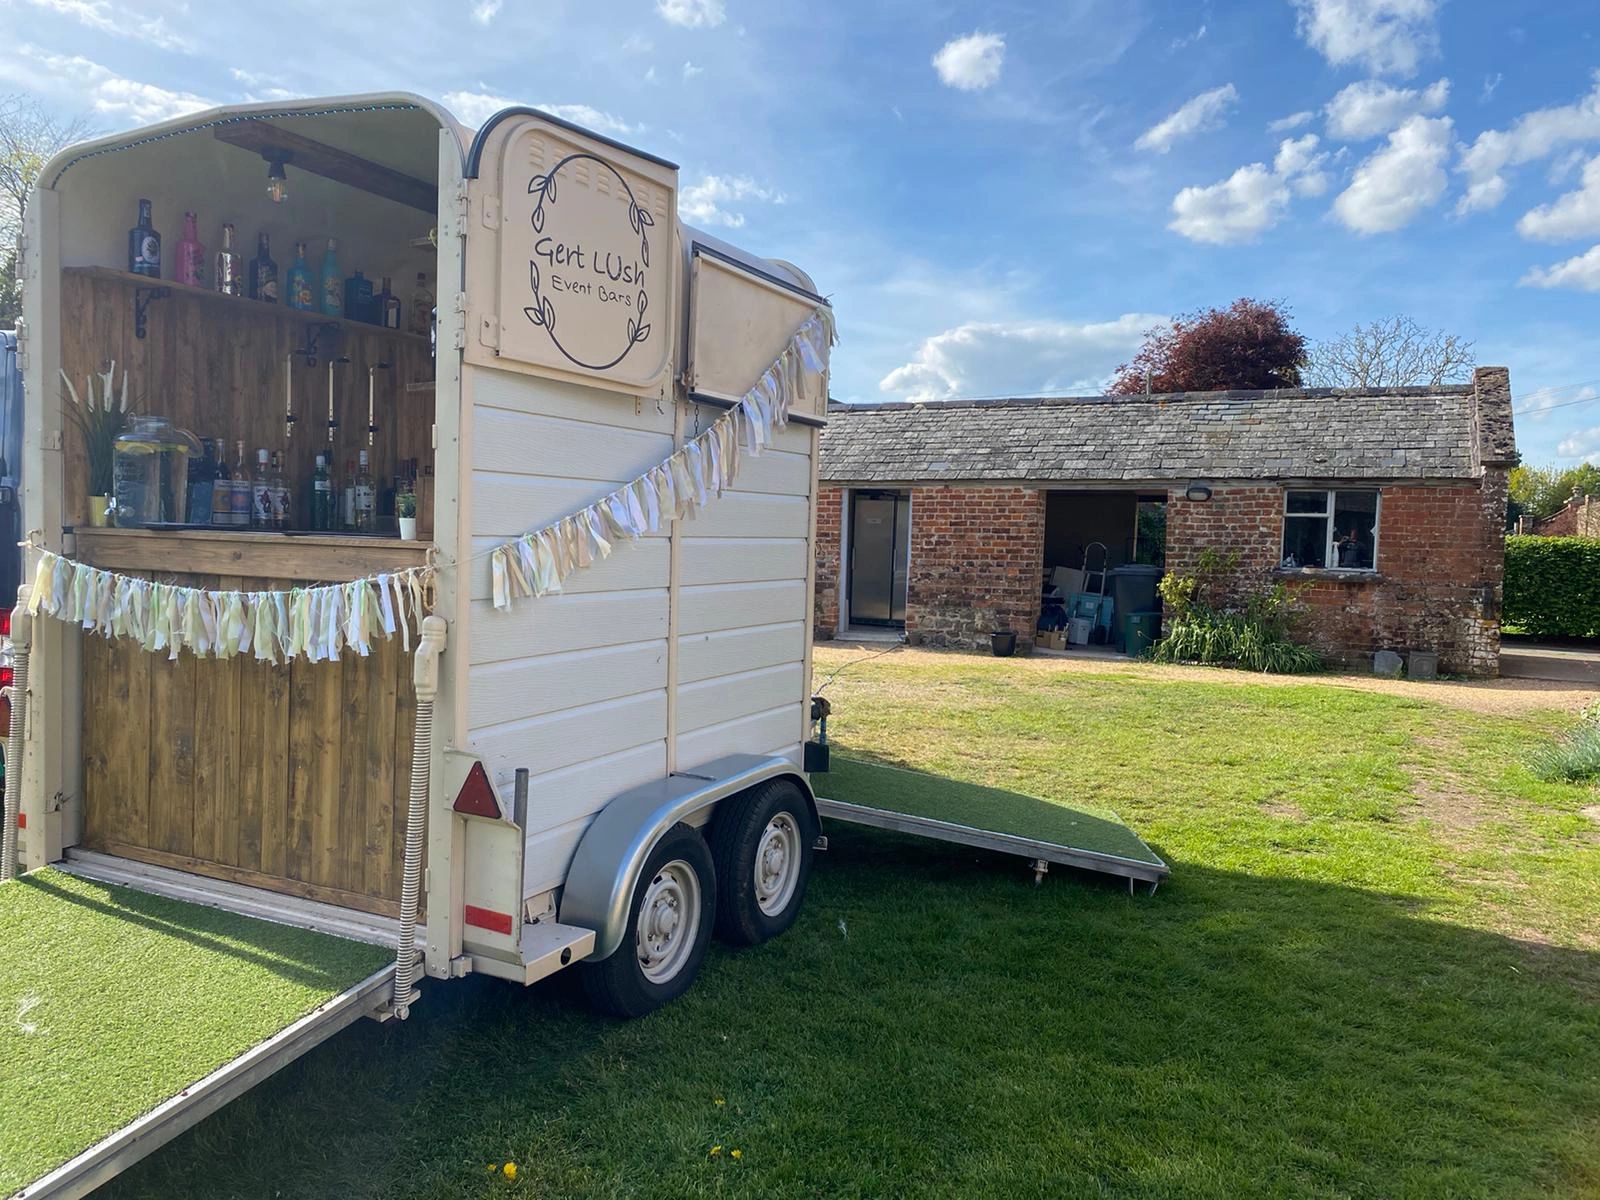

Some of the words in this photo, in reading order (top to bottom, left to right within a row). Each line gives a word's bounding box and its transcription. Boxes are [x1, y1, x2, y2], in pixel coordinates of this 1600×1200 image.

[535, 237, 585, 269] Gert
[551, 275, 592, 295] Event
[599, 285, 632, 306] Bars
